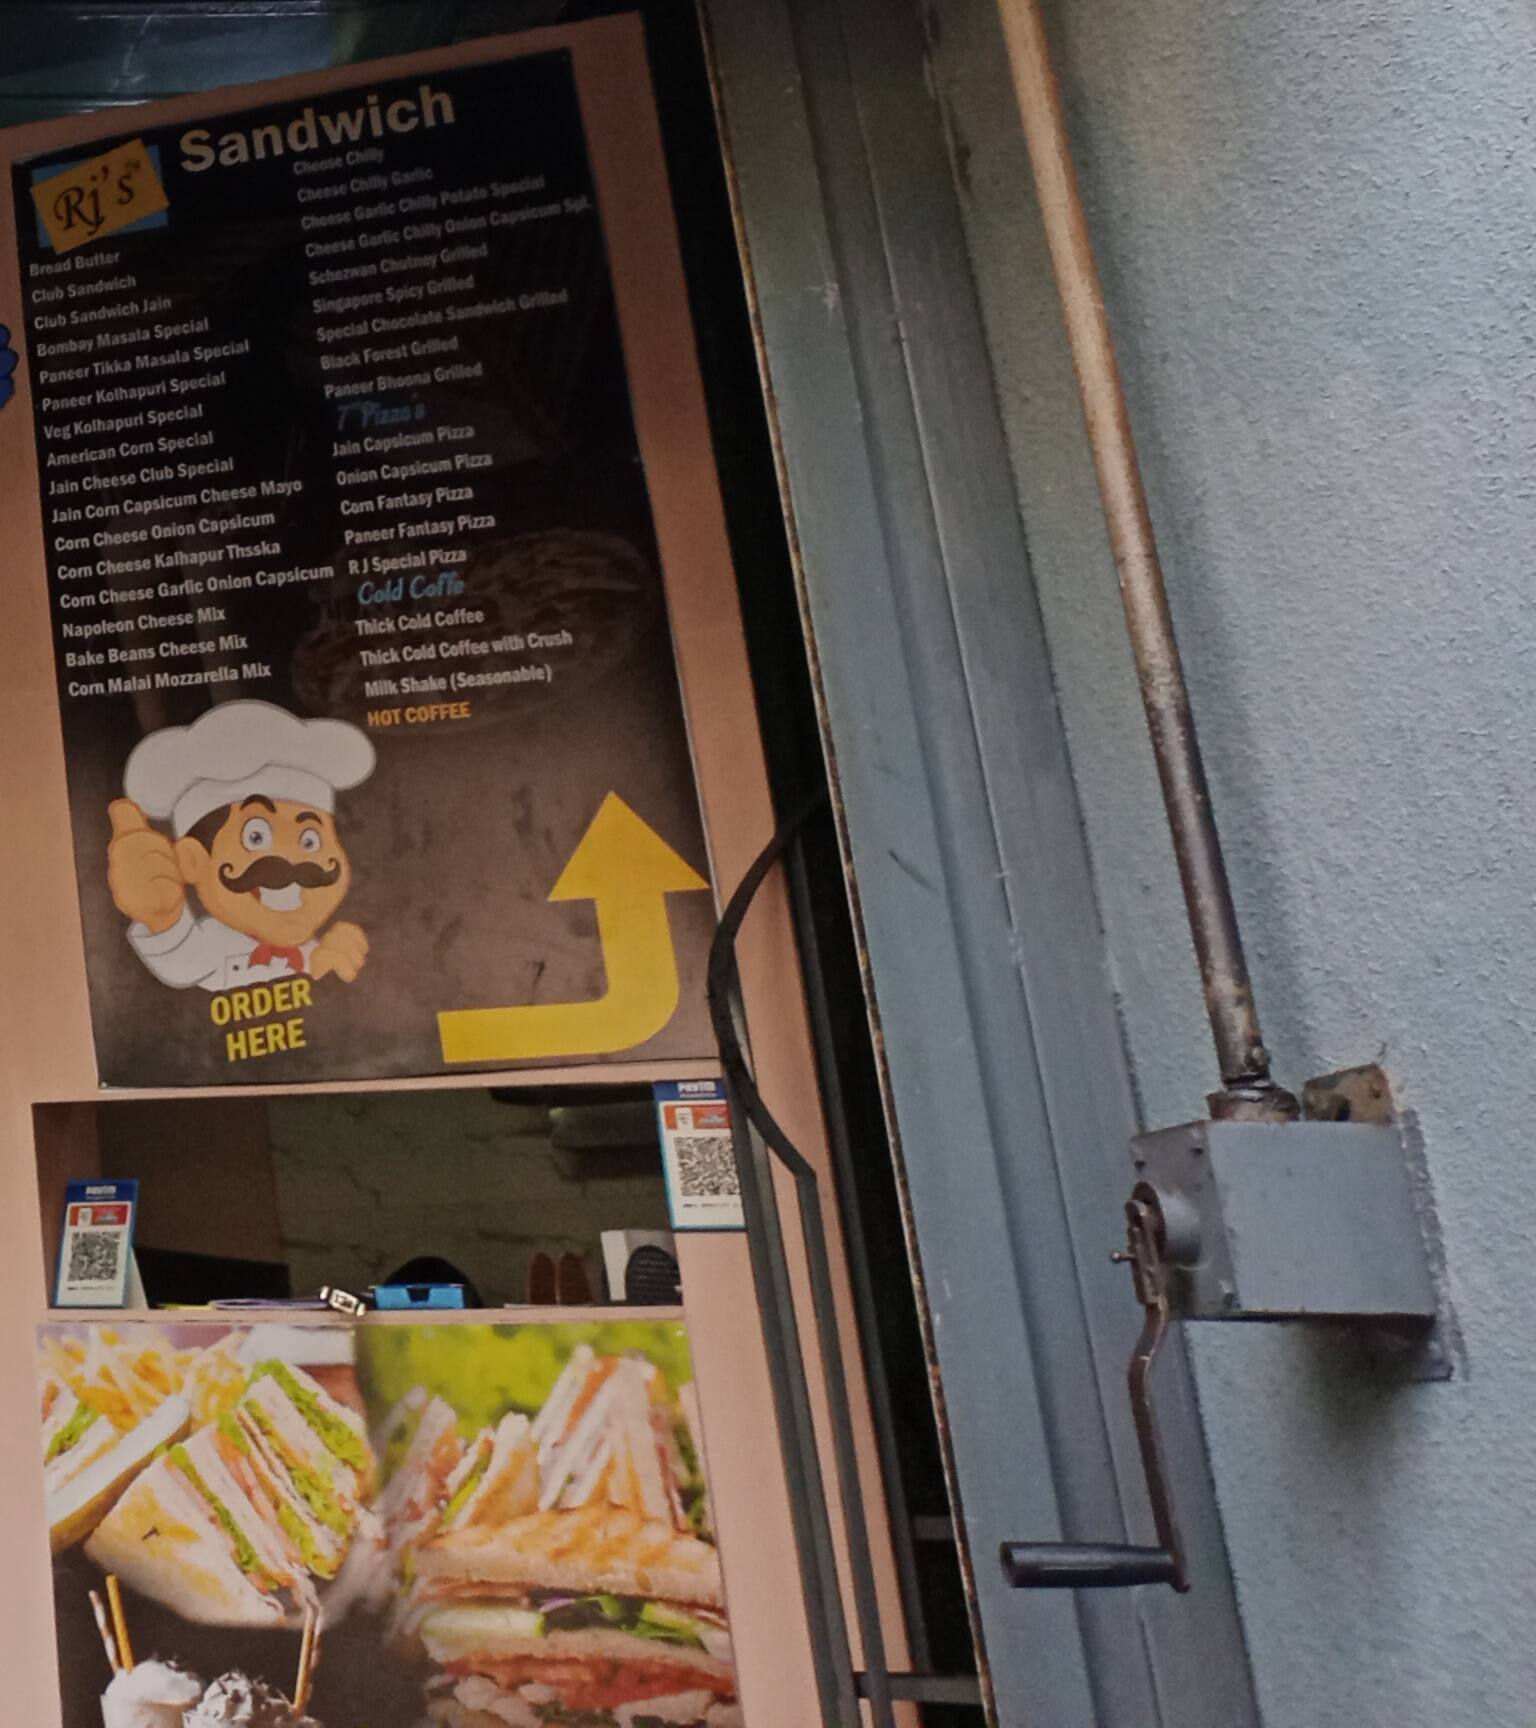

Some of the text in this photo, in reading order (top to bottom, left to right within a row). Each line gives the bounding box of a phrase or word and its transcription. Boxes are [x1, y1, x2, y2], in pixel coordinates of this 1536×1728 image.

[180, 86, 456, 172] Sandwich
[294, 147, 384, 175] Cheese Chilly
[298, 168, 433, 202] Cheese Chilly Garlic
[301, 176, 544, 230] Cheese Garlic Chilly Potato Special
[306, 240, 355, 257] Cheese
[359, 232, 400, 248] Garlic
[403, 223, 442, 240] Chilly
[445, 218, 487, 233] Onion
[30, 251, 121, 277] Bread Butter
[381, 256, 437, 274] Chutney
[440, 244, 488, 263] Grilled
[32, 276, 137, 302] Club Sandwich
[313, 275, 474, 313] Singapore Spicy Grilled
[34, 296, 172, 329] Club Sandwich Jain
[317, 289, 568, 342] Special Chocolate Sandwich Grilled
[37, 318, 209, 356] Bombay Masala Special
[320, 336, 459, 370] Black Forest Grilled
[40, 340, 249, 384] Paneer Tikka Masala Special
[42, 372, 226, 410] Paneer Kolhapuri Special
[324, 380, 374, 398] Paneer
[434, 362, 483, 381] Grilled
[44, 404, 203, 439] Veg Kolhapuri Special
[47, 431, 214, 466] American Corn Special
[332, 425, 475, 456] Jain Capsicum Pizza
[49, 458, 234, 495] Jain Cheese Club Special
[337, 453, 493, 485] Onion Capsicum Pizza
[52, 480, 302, 523] Jain Corn Capsicum Cheese Mayo
[341, 486, 474, 515] Corn Fantasy Pizza
[55, 513, 275, 551] Corn Cheese Onion Capsicum
[345, 514, 496, 545] Paneer Fantasy Pizza
[58, 565, 93, 579] Corn
[96, 557, 151, 575] Cheese
[372, 552, 425, 573] Special
[429, 549, 467, 565] Pizza
[60, 565, 334, 608] Corn Cheese Garlic Onion Capsicum
[358, 578, 403, 606] Cold
[63, 607, 226, 640] Napoleon Cheese Mix
[355, 608, 485, 636] Thick Cold Coffee
[66, 634, 248, 667] Bake Beans Cheese Mix
[359, 629, 574, 667] Thick Cold Coffee with Crush
[69, 662, 272, 696] Corn Malai Mozzarella Mix
[364, 680, 398, 698] Milk
[401, 677, 447, 694] Shake
[368, 701, 471, 727] HOT COFFEE
[210, 978, 313, 1026] ORDER
[226, 1019, 306, 1063] HERE
